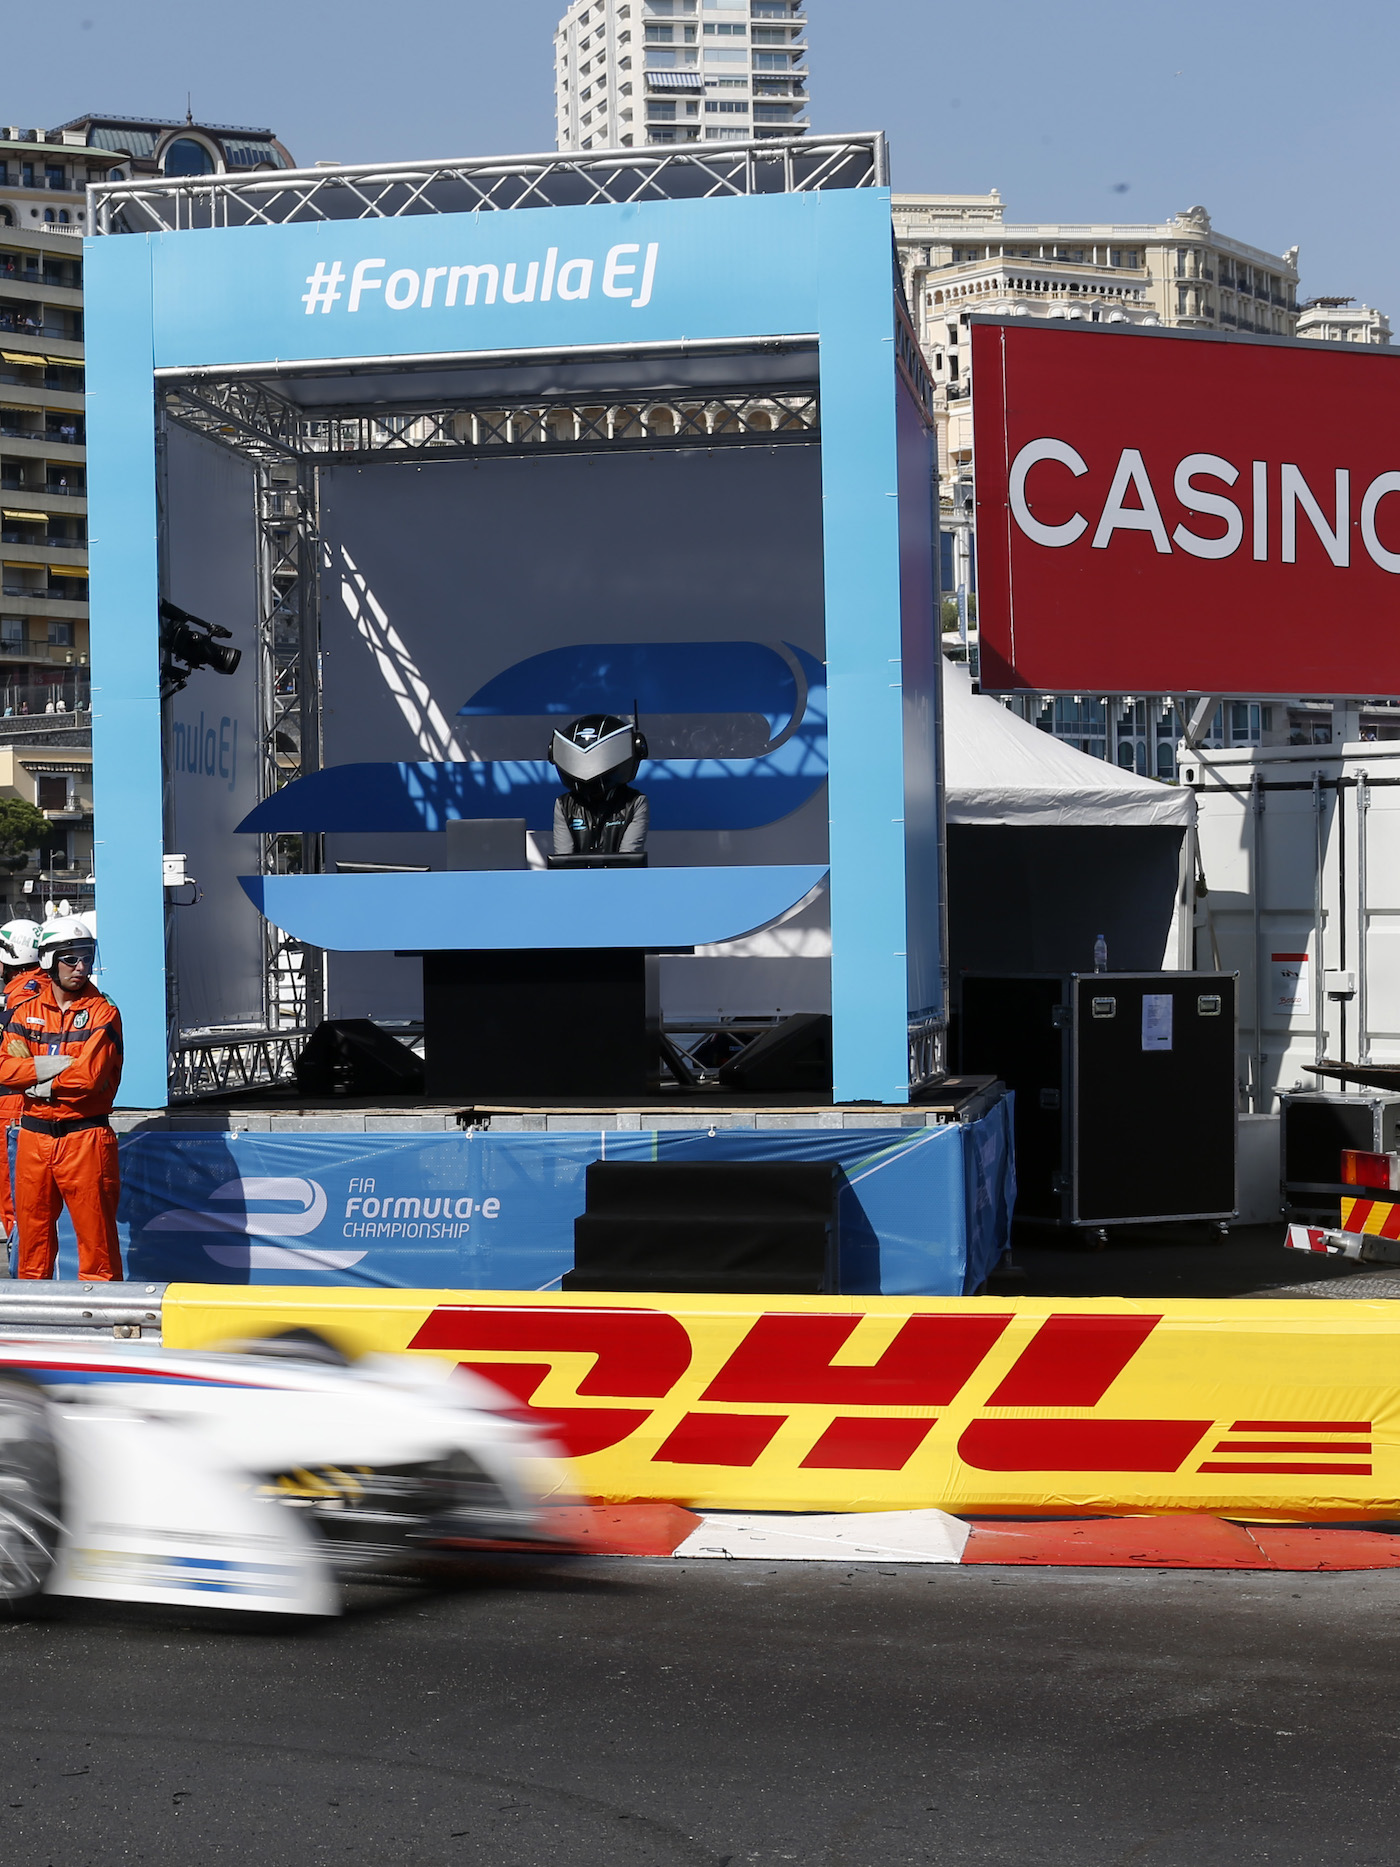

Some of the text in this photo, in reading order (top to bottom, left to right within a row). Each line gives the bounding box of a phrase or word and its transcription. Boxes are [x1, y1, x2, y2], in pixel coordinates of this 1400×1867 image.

[301, 242, 660, 315] #FormulaEJ
[50, 1044, 58, 1056] 7
[348, 1177, 376, 1193] FIA
[342, 1222, 470, 1239] CHAMPIONSHIP
[407, 1305, 1215, 1473] DHL
